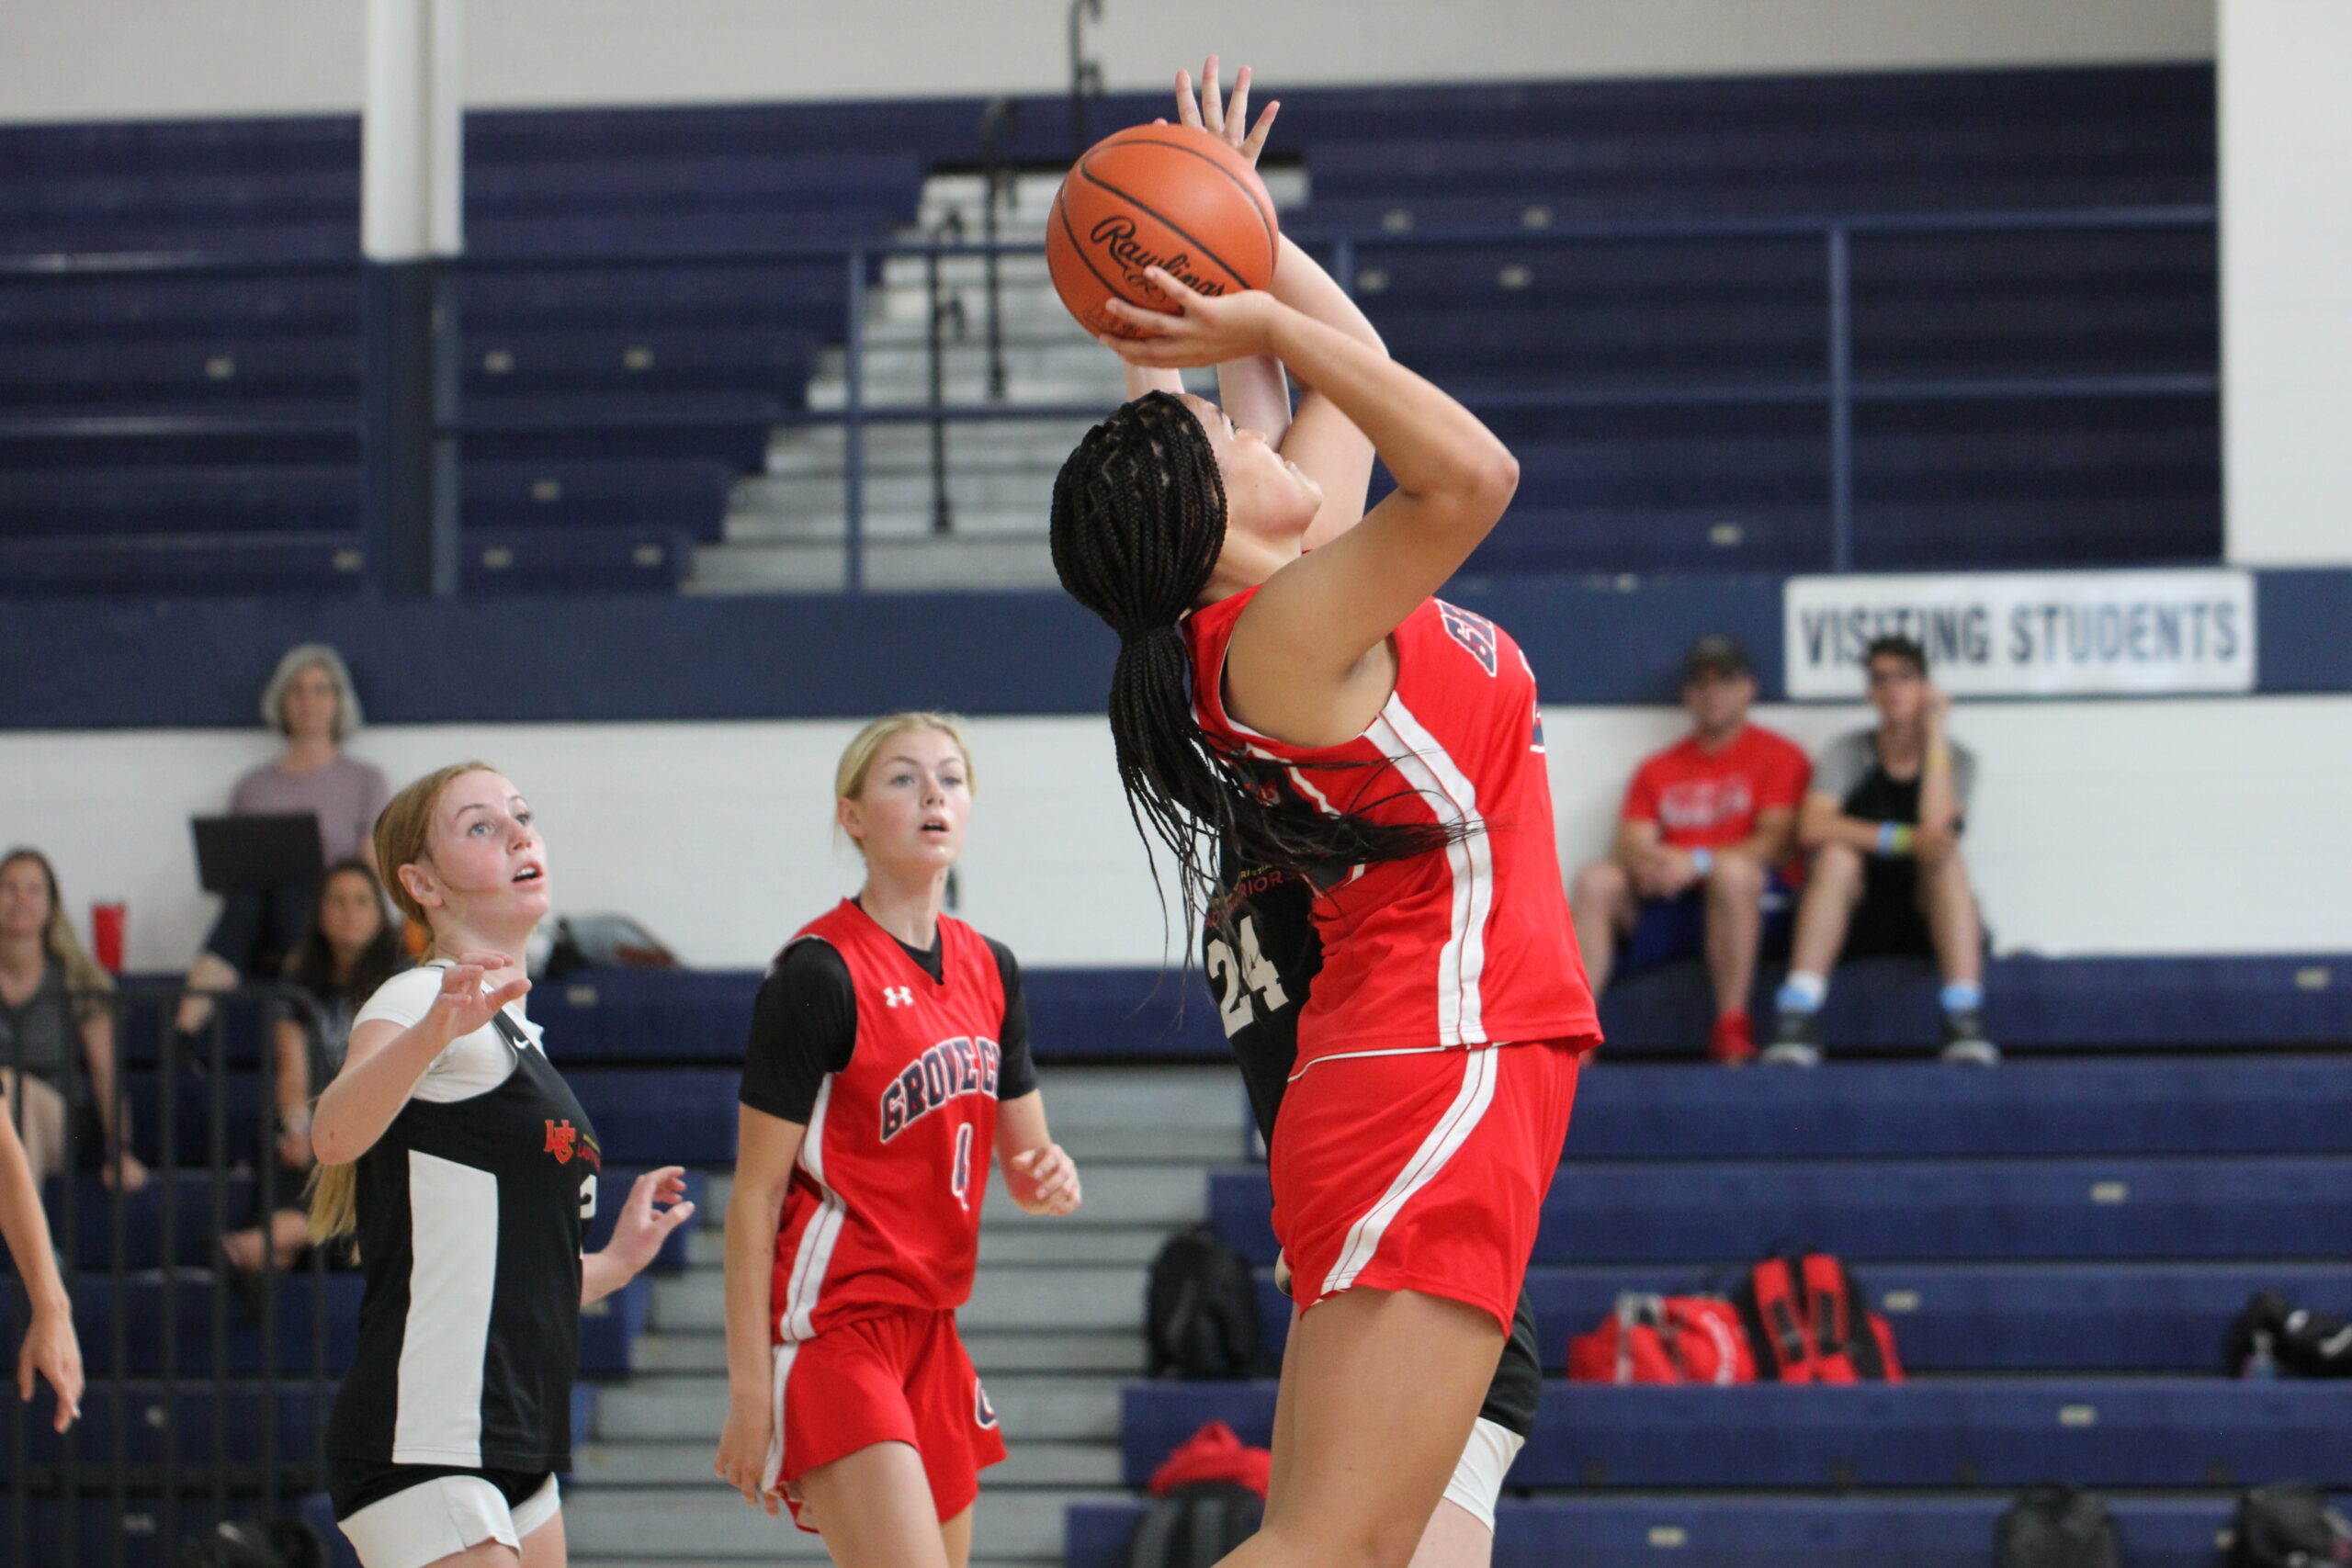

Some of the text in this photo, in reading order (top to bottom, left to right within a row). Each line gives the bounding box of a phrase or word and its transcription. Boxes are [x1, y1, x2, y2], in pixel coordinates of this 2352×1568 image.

[2009, 599, 2239, 665] STUDENTS
[1207, 915, 1290, 1039] 24
[879, 1036, 978, 1145] GROVE
